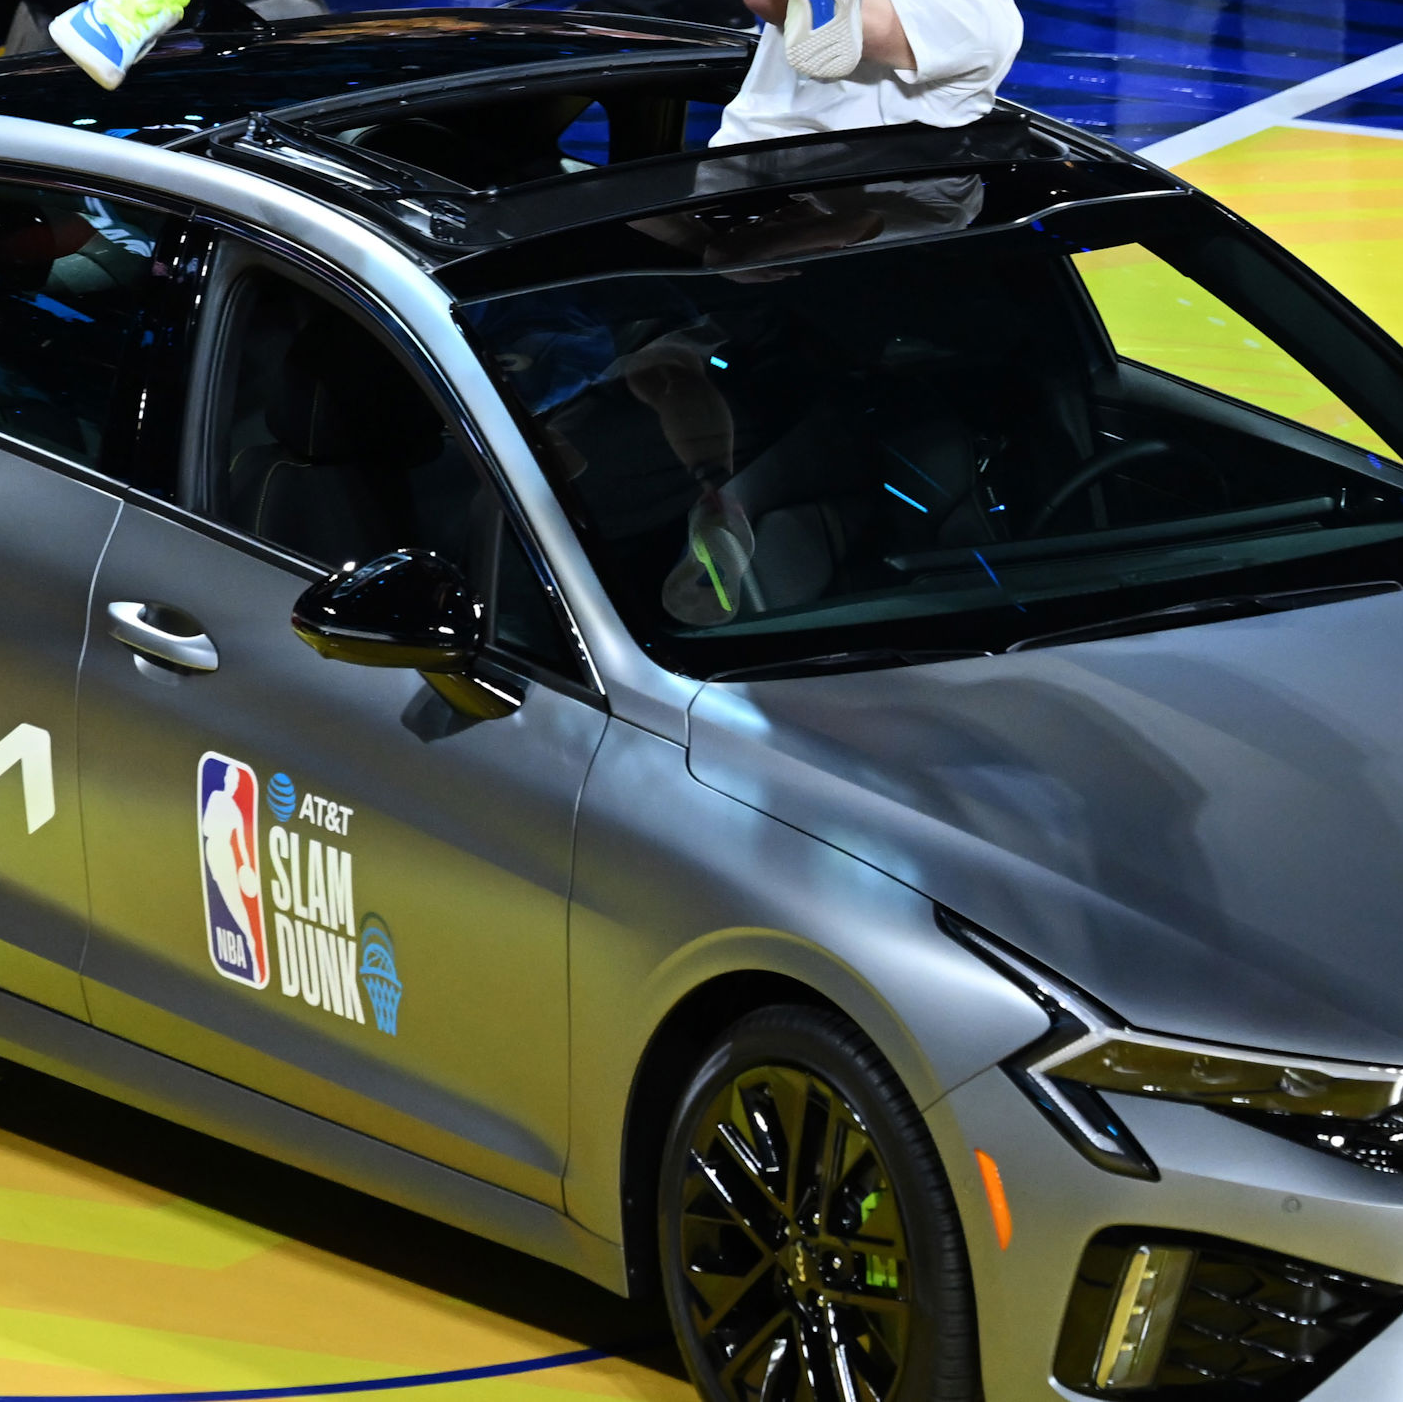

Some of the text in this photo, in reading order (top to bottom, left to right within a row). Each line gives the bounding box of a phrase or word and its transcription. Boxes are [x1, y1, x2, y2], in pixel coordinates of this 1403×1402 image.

[299, 792, 354, 836] AT&T
[269, 825, 356, 937] SLAM
[217, 926, 248, 971] NBA
[275, 910, 366, 1025] DUNK
